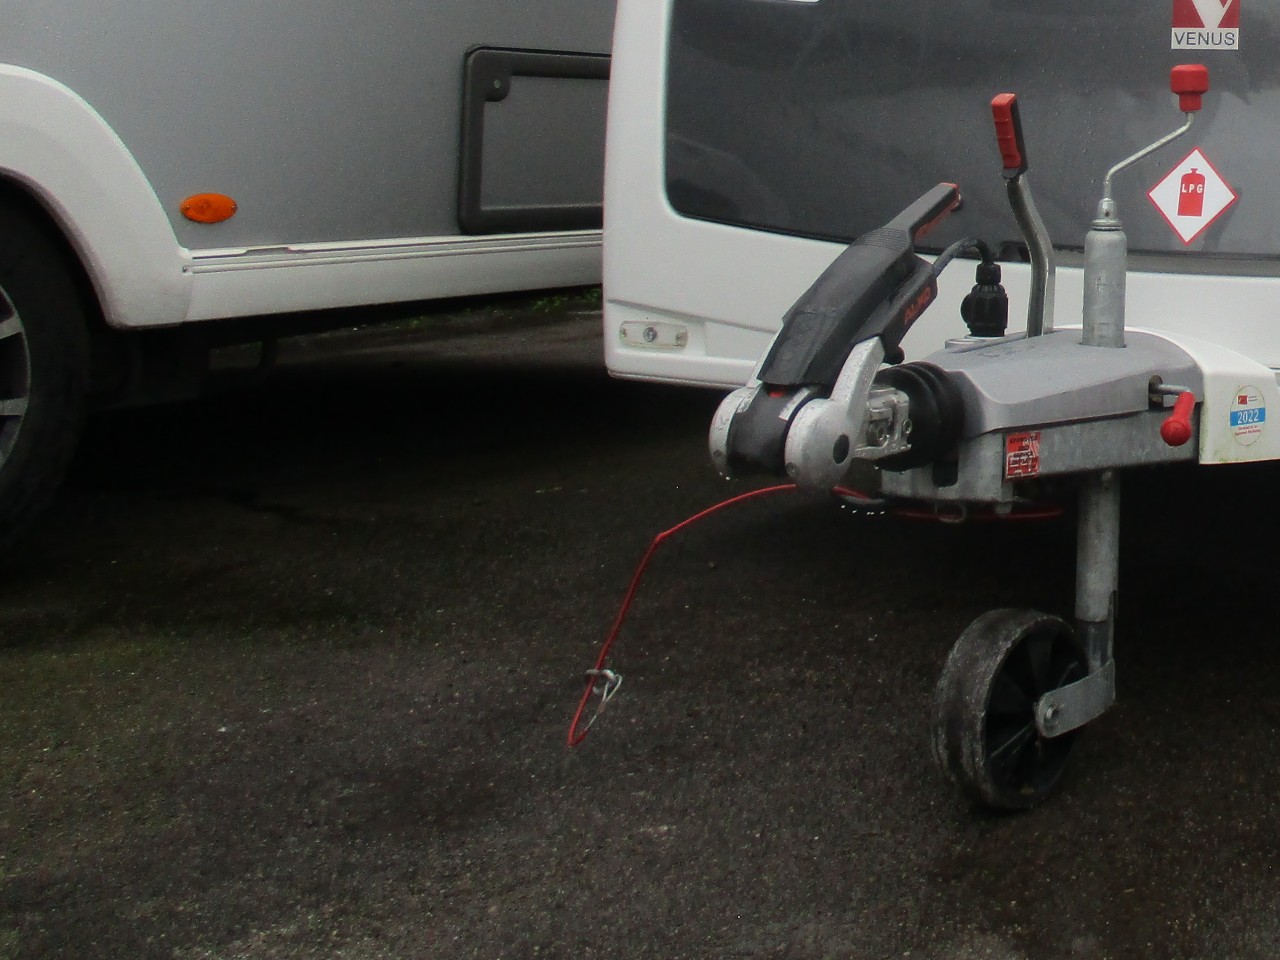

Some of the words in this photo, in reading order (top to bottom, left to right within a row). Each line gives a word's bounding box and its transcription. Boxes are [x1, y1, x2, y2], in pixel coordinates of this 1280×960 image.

[1174, 31, 1235, 45] VENUS
[1182, 183, 1203, 194] LPG
[1237, 409, 1259, 424] 2022
